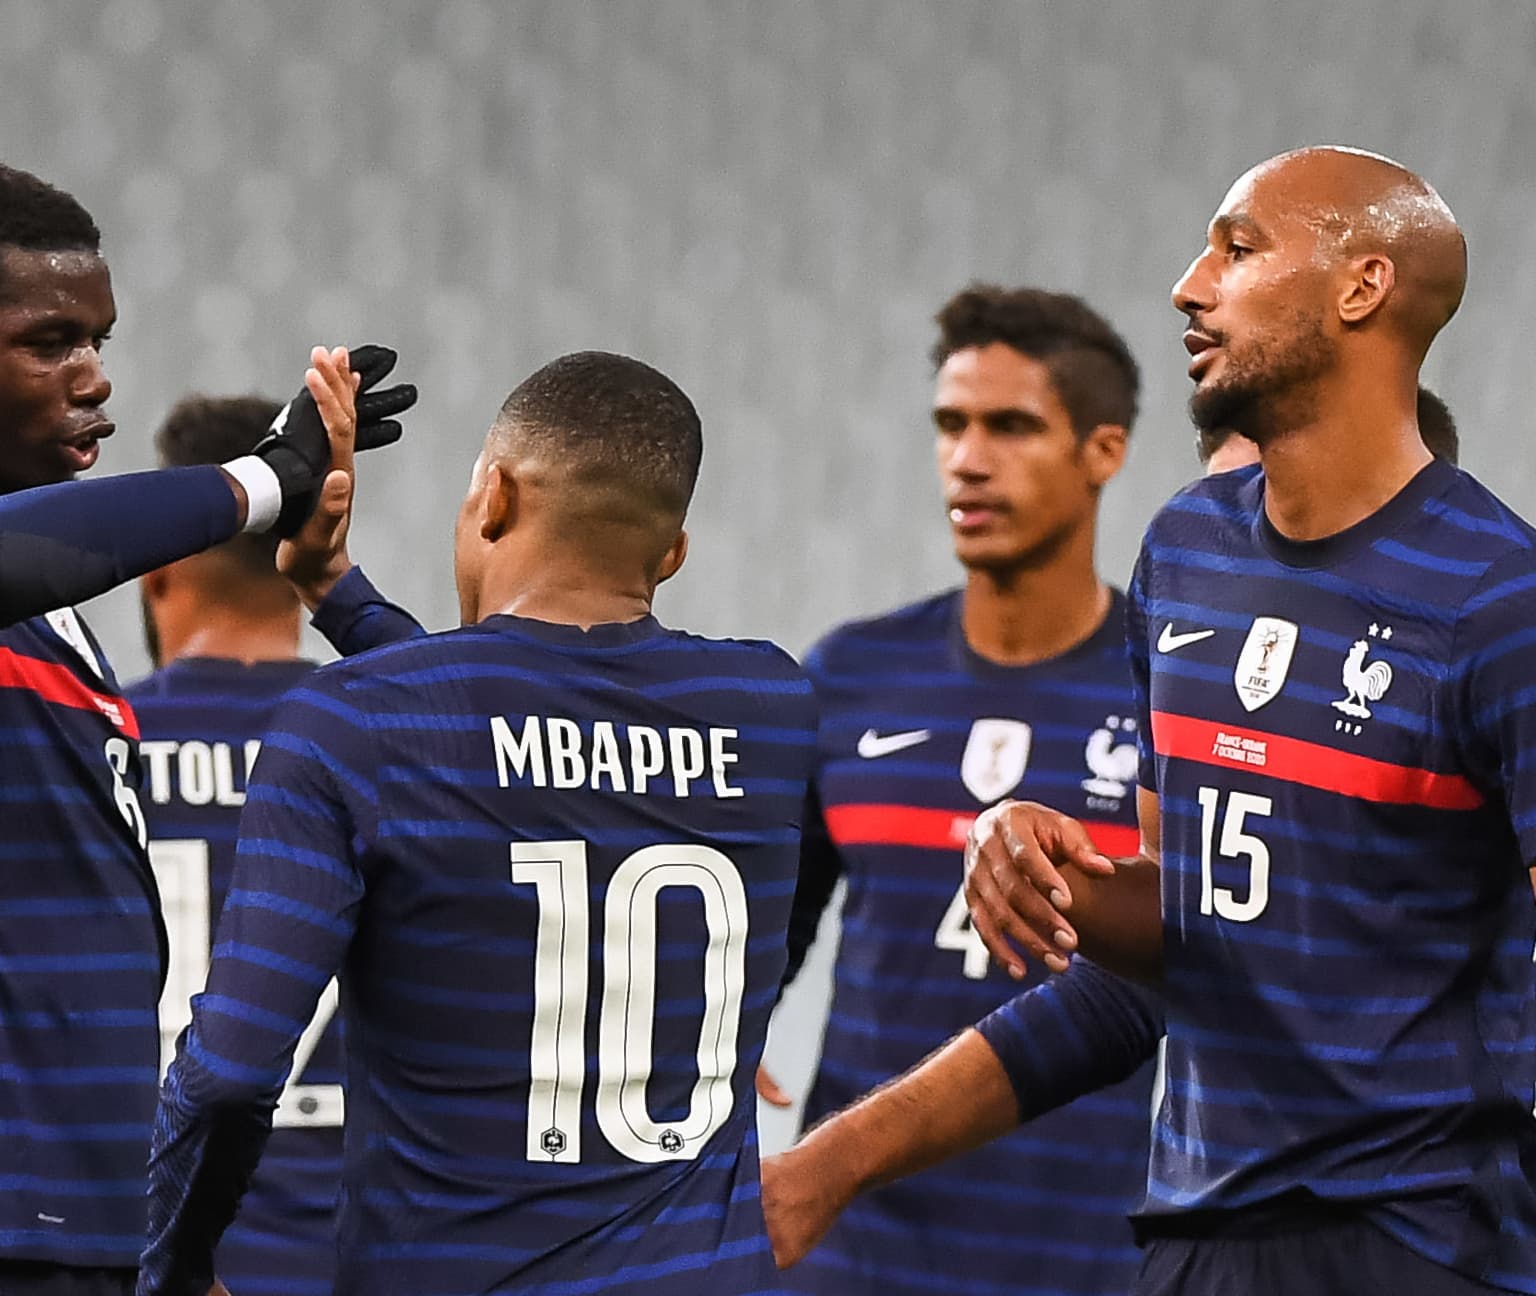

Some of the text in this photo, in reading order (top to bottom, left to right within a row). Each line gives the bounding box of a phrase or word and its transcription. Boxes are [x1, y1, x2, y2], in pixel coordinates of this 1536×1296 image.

[490, 715, 744, 798] MBAPPE
[1198, 786, 1272, 922] 15
[509, 839, 748, 1164] 10
